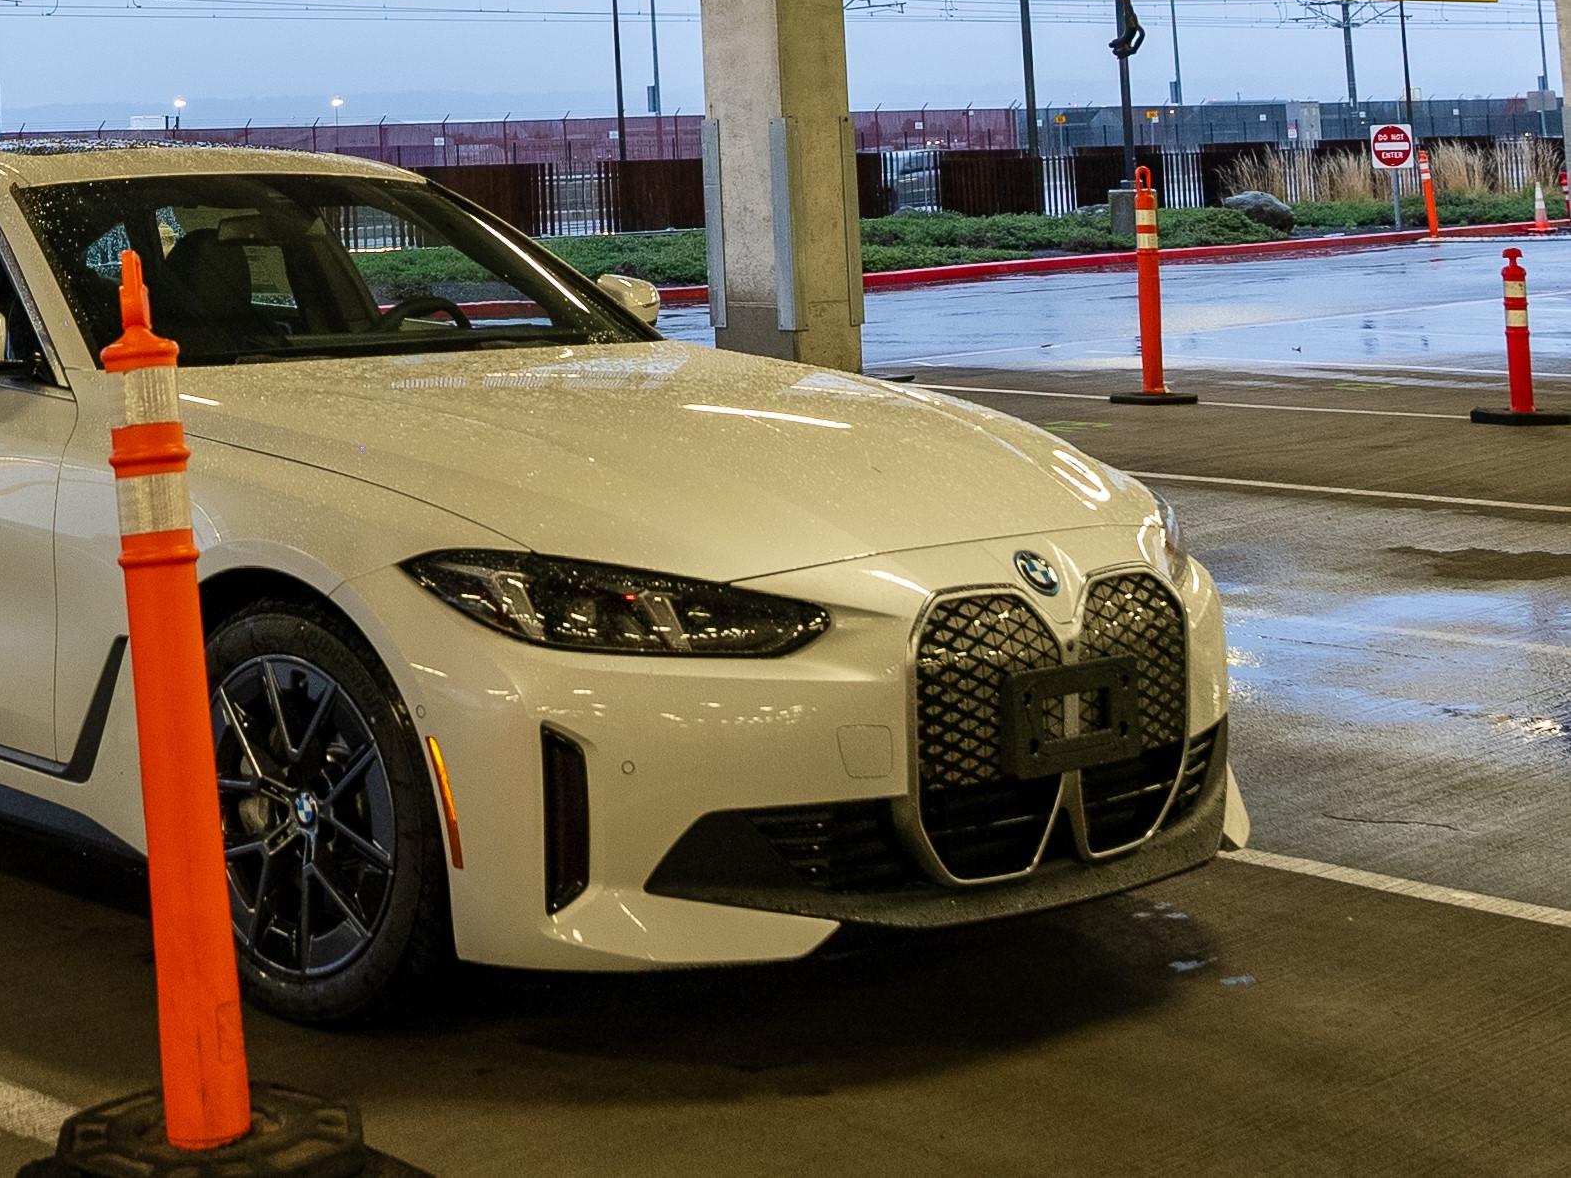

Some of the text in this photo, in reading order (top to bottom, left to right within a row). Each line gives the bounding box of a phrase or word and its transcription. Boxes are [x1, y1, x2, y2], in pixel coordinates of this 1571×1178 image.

[1377, 133, 1404, 141] DO NOT
[1381, 151, 1403, 159] ENTER
